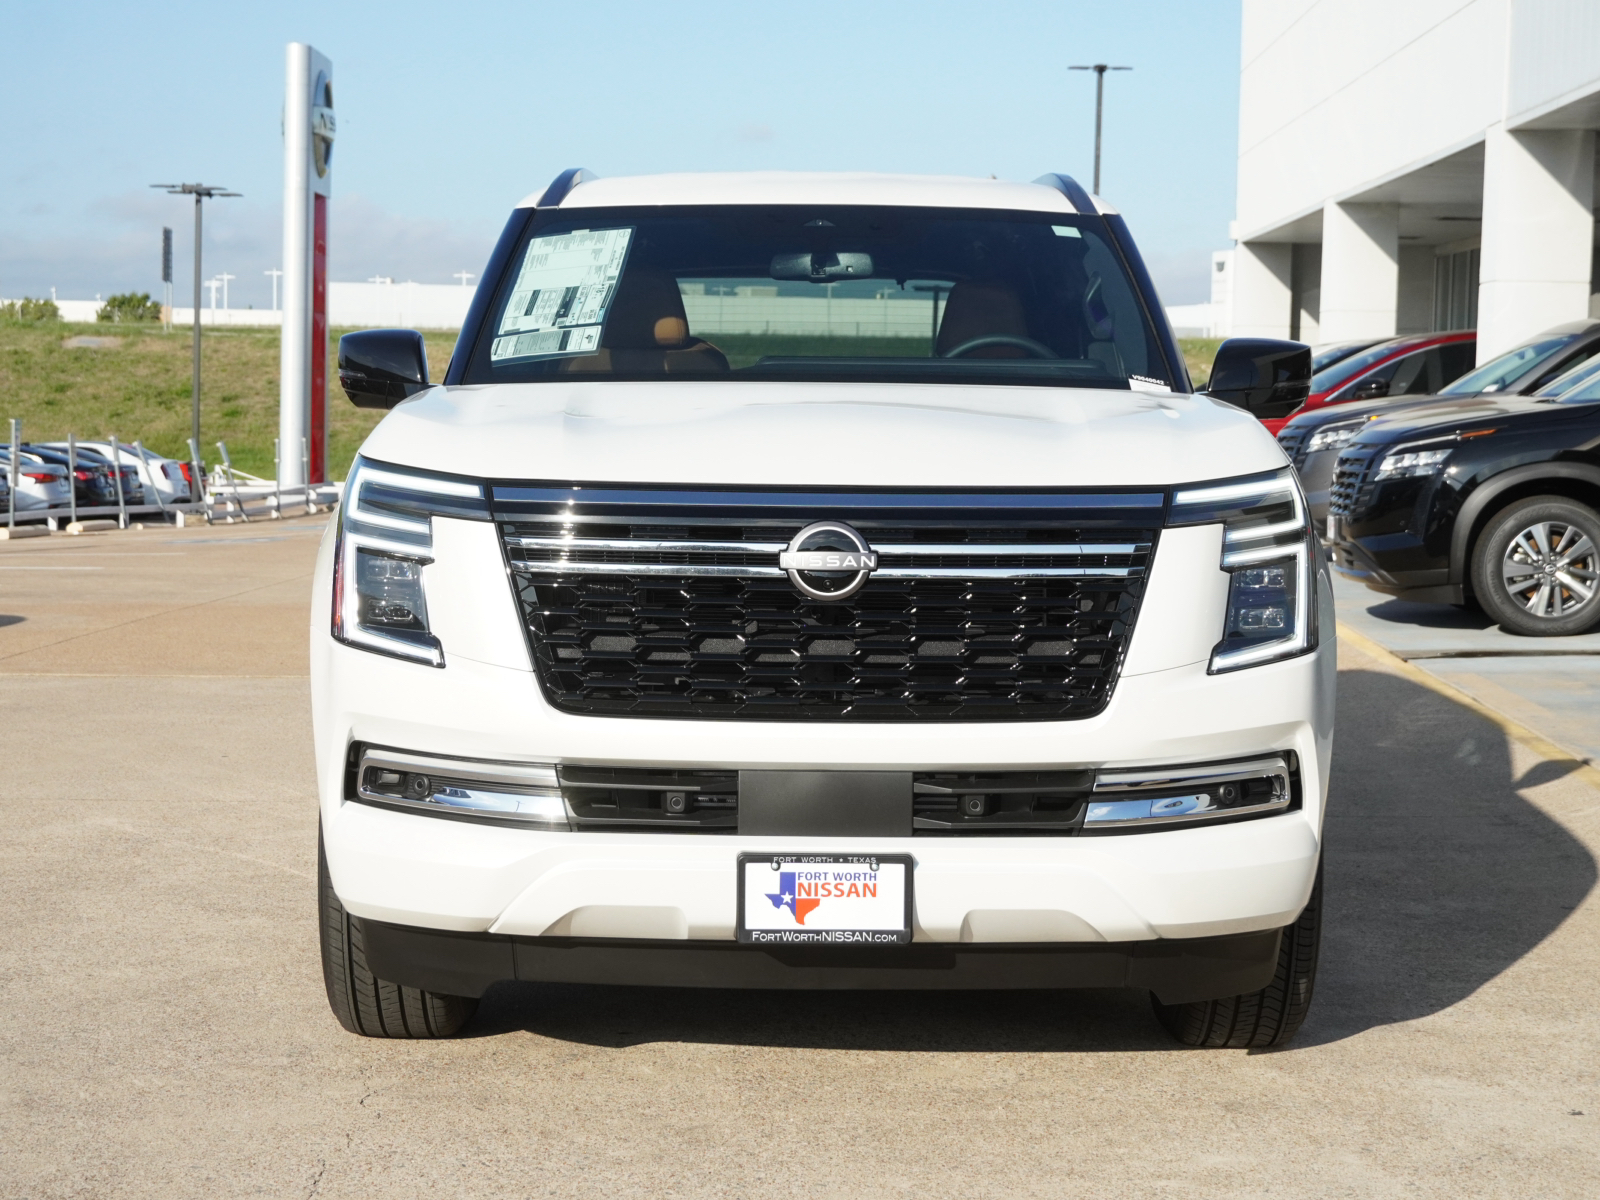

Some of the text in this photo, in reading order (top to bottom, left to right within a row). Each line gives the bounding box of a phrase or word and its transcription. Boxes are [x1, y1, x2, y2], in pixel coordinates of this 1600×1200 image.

[783, 555, 875, 567] NISSAN
[797, 872, 877, 881] FORT WORTH
[797, 882, 877, 898] NISSAN
